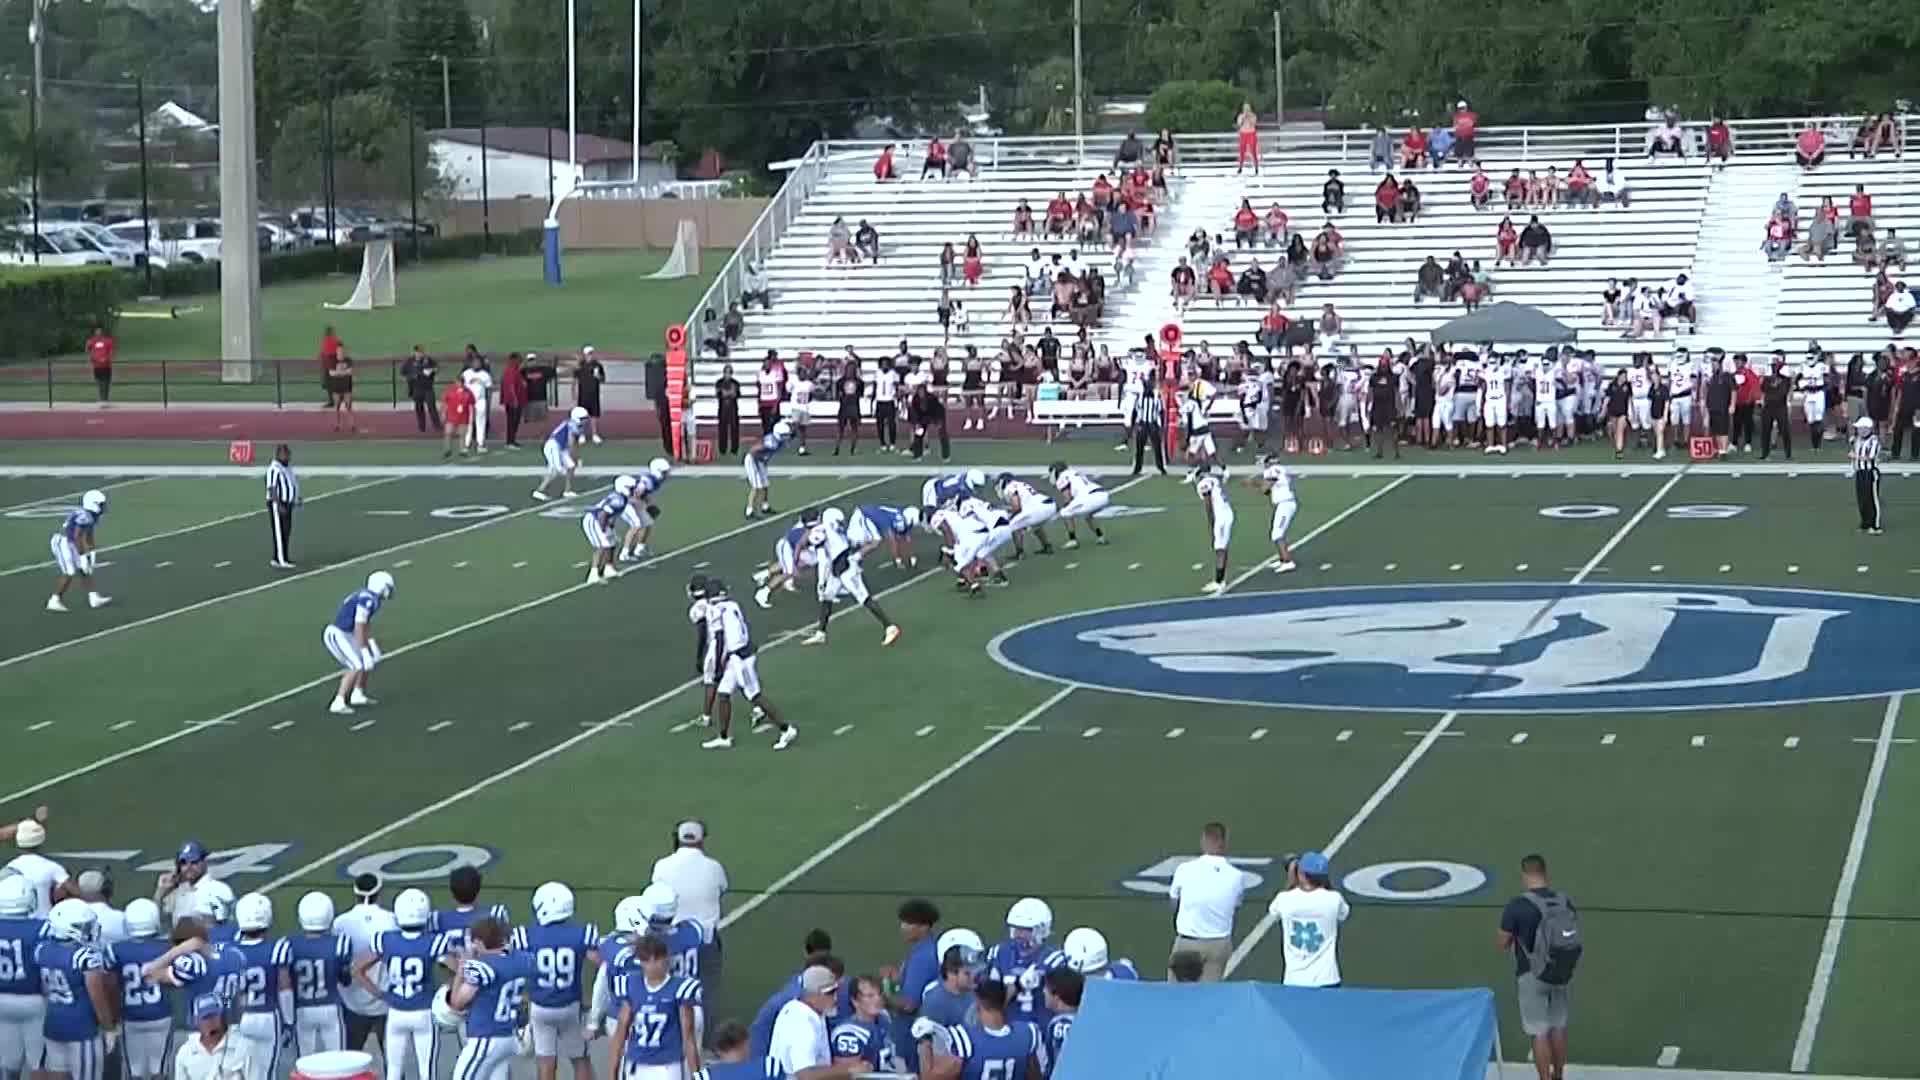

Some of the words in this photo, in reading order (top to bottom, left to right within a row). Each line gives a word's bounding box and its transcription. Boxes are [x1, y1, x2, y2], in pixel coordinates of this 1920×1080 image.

[1693, 440, 1713, 457] 50
[1121, 856, 1487, 901] 50
[0, 940, 26, 980] 61
[295, 960, 328, 1000] 21
[385, 957, 424, 1000] 42
[536, 947, 576, 988] 99
